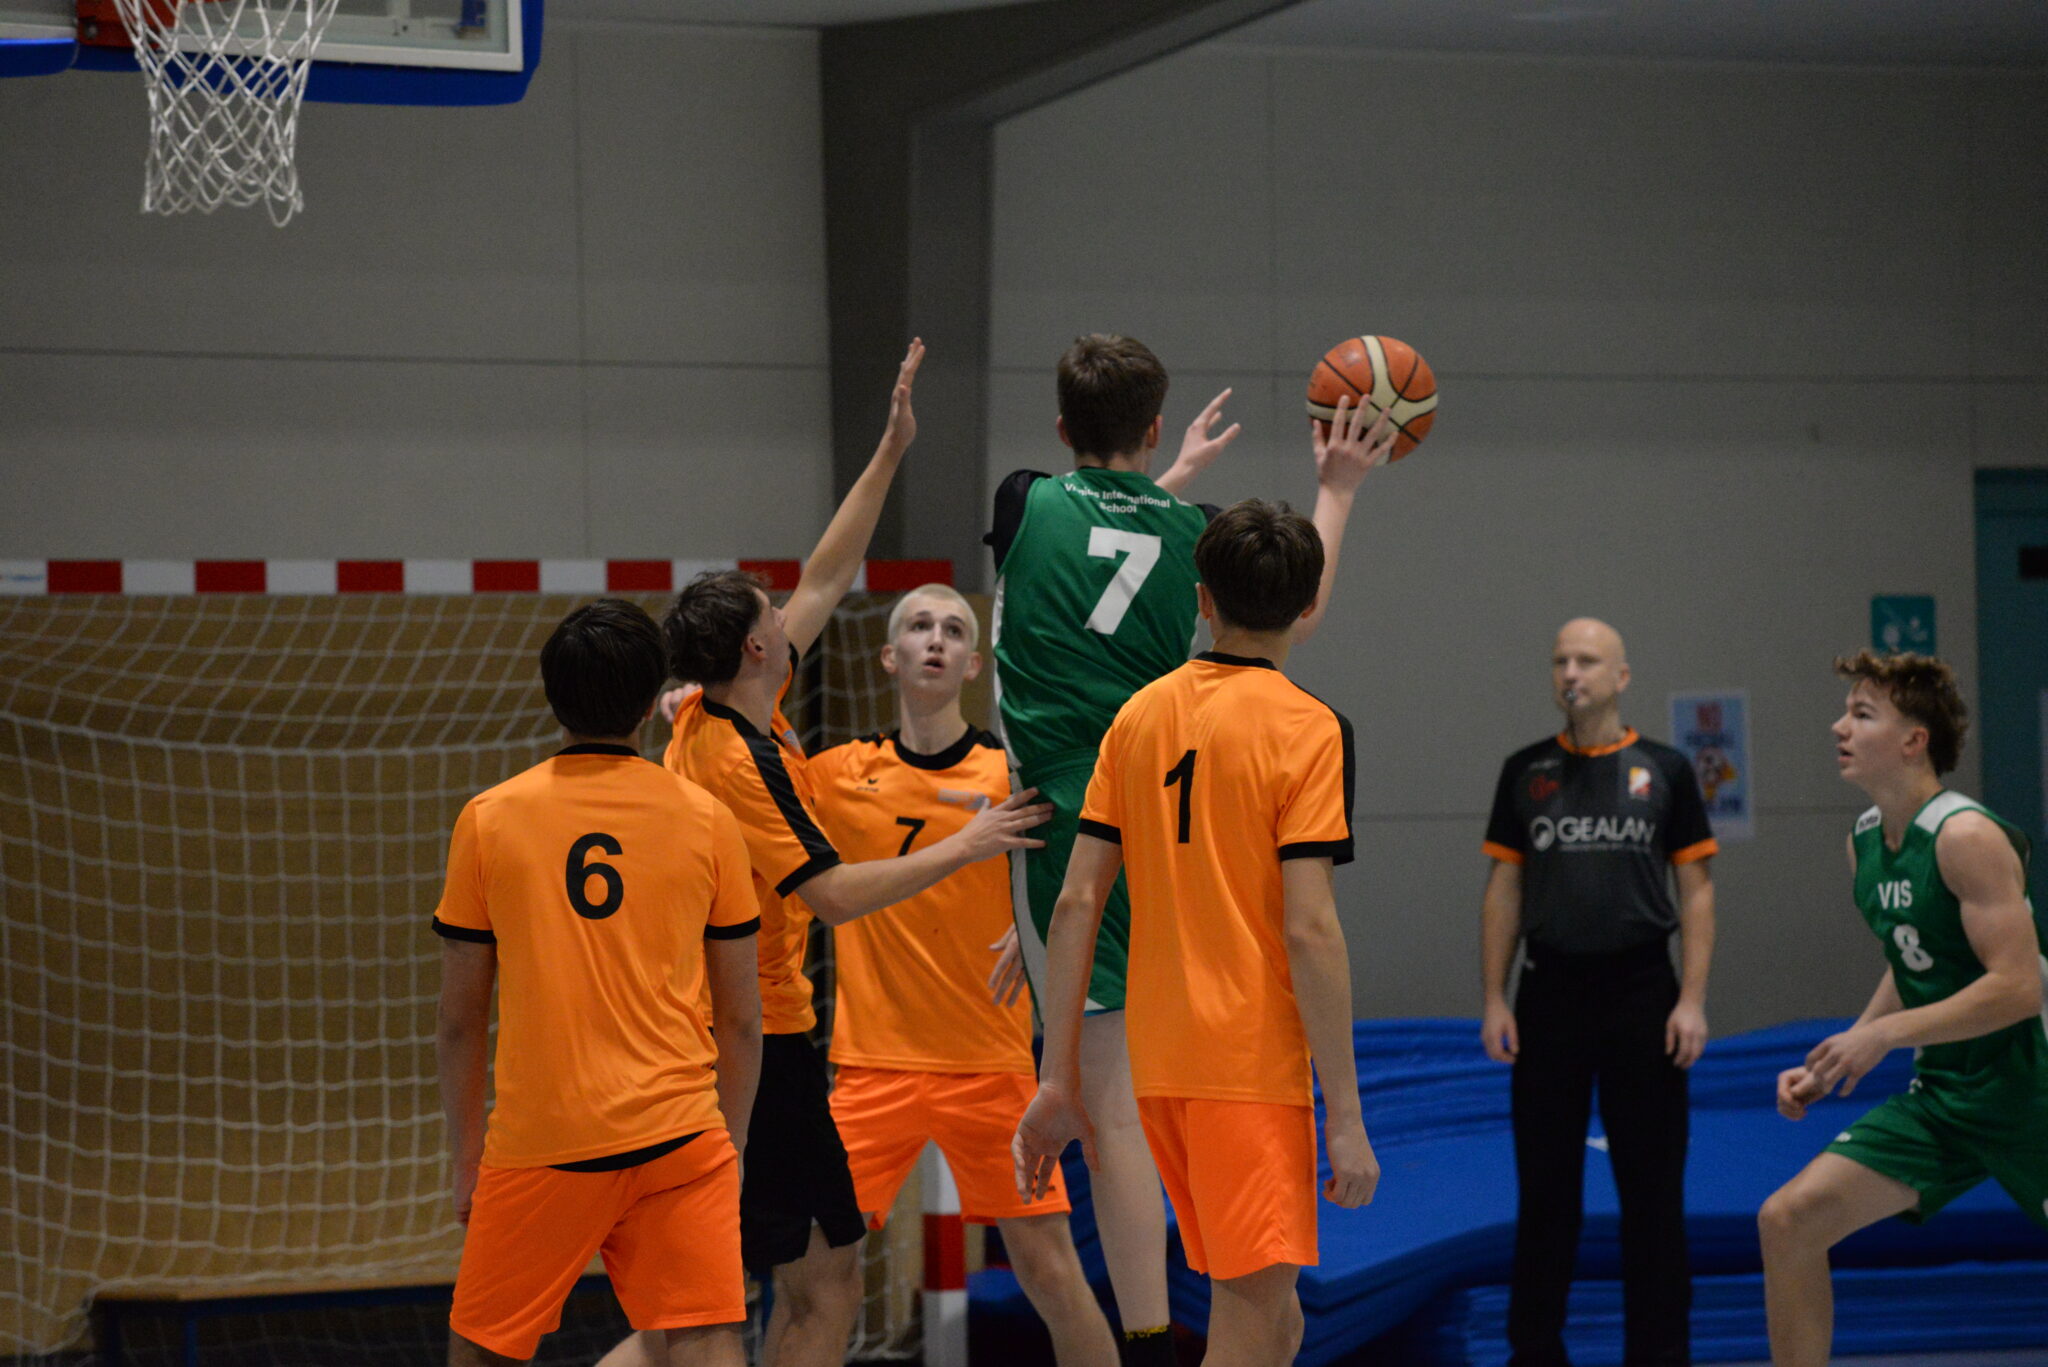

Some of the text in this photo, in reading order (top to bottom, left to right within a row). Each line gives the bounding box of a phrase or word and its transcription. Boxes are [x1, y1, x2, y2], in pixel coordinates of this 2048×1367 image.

[1100, 501, 1137, 513] School
[1102, 490, 1171, 508] International
[1084, 526, 1162, 635] 7
[1163, 749, 1197, 844] 1
[895, 816, 926, 857] 7
[1557, 816, 1656, 844] GEALAN
[565, 832, 624, 920] 6
[1878, 879, 1914, 910] VIS
[1893, 924, 1934, 972] 8
